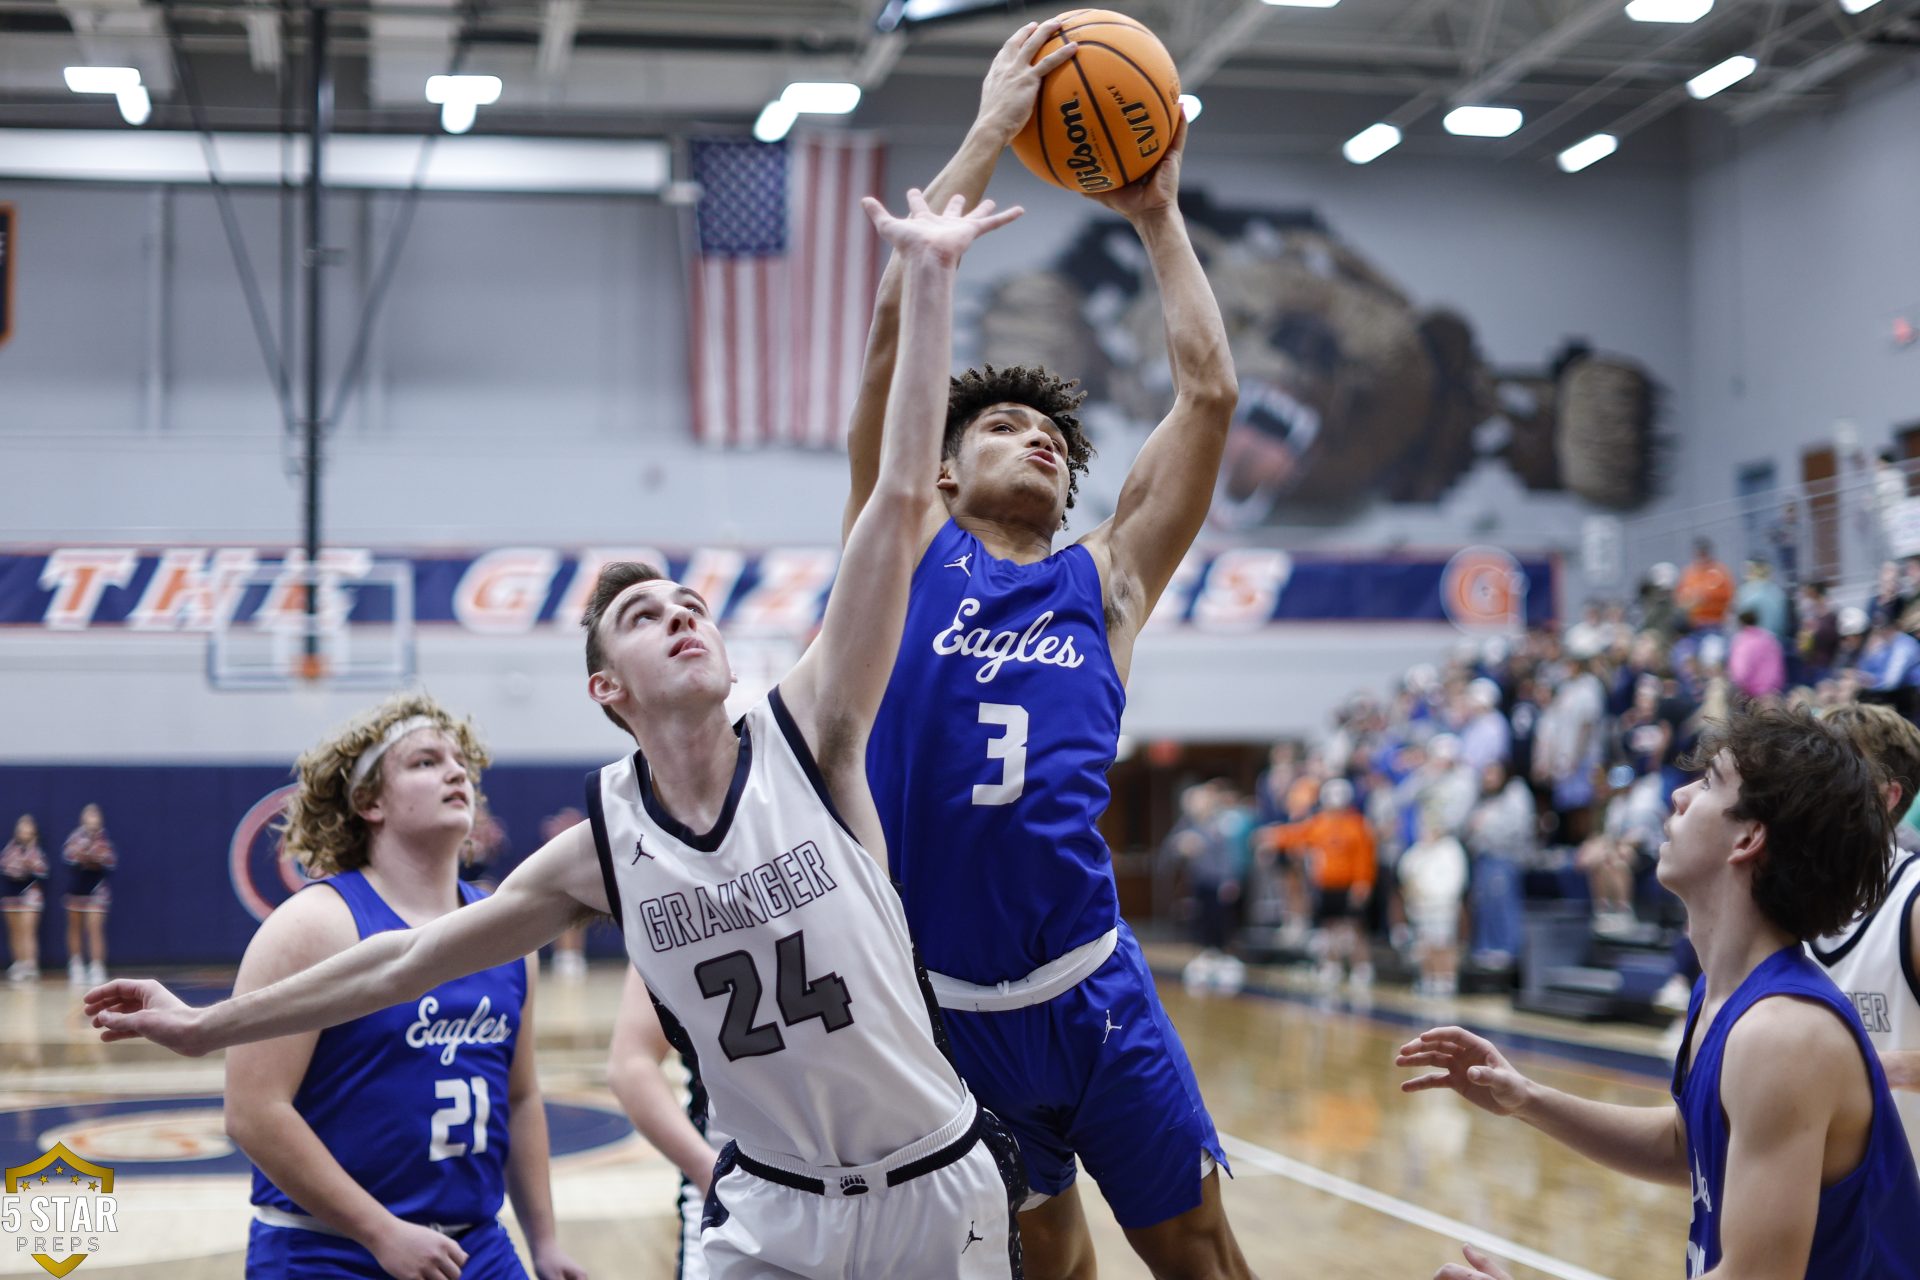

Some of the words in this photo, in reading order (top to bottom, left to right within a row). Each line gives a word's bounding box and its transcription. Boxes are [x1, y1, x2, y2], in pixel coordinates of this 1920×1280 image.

[1106, 84, 1127, 106] NXT
[1060, 98, 1115, 192] Wilson
[38, 547, 374, 632] THE
[931, 597, 1085, 684] Eagles
[971, 702, 1029, 806] 3
[639, 840, 838, 953] GRAINGER
[405, 995, 513, 1066] Eagles
[694, 929, 855, 1062] 24
[428, 1076, 491, 1162] 21
